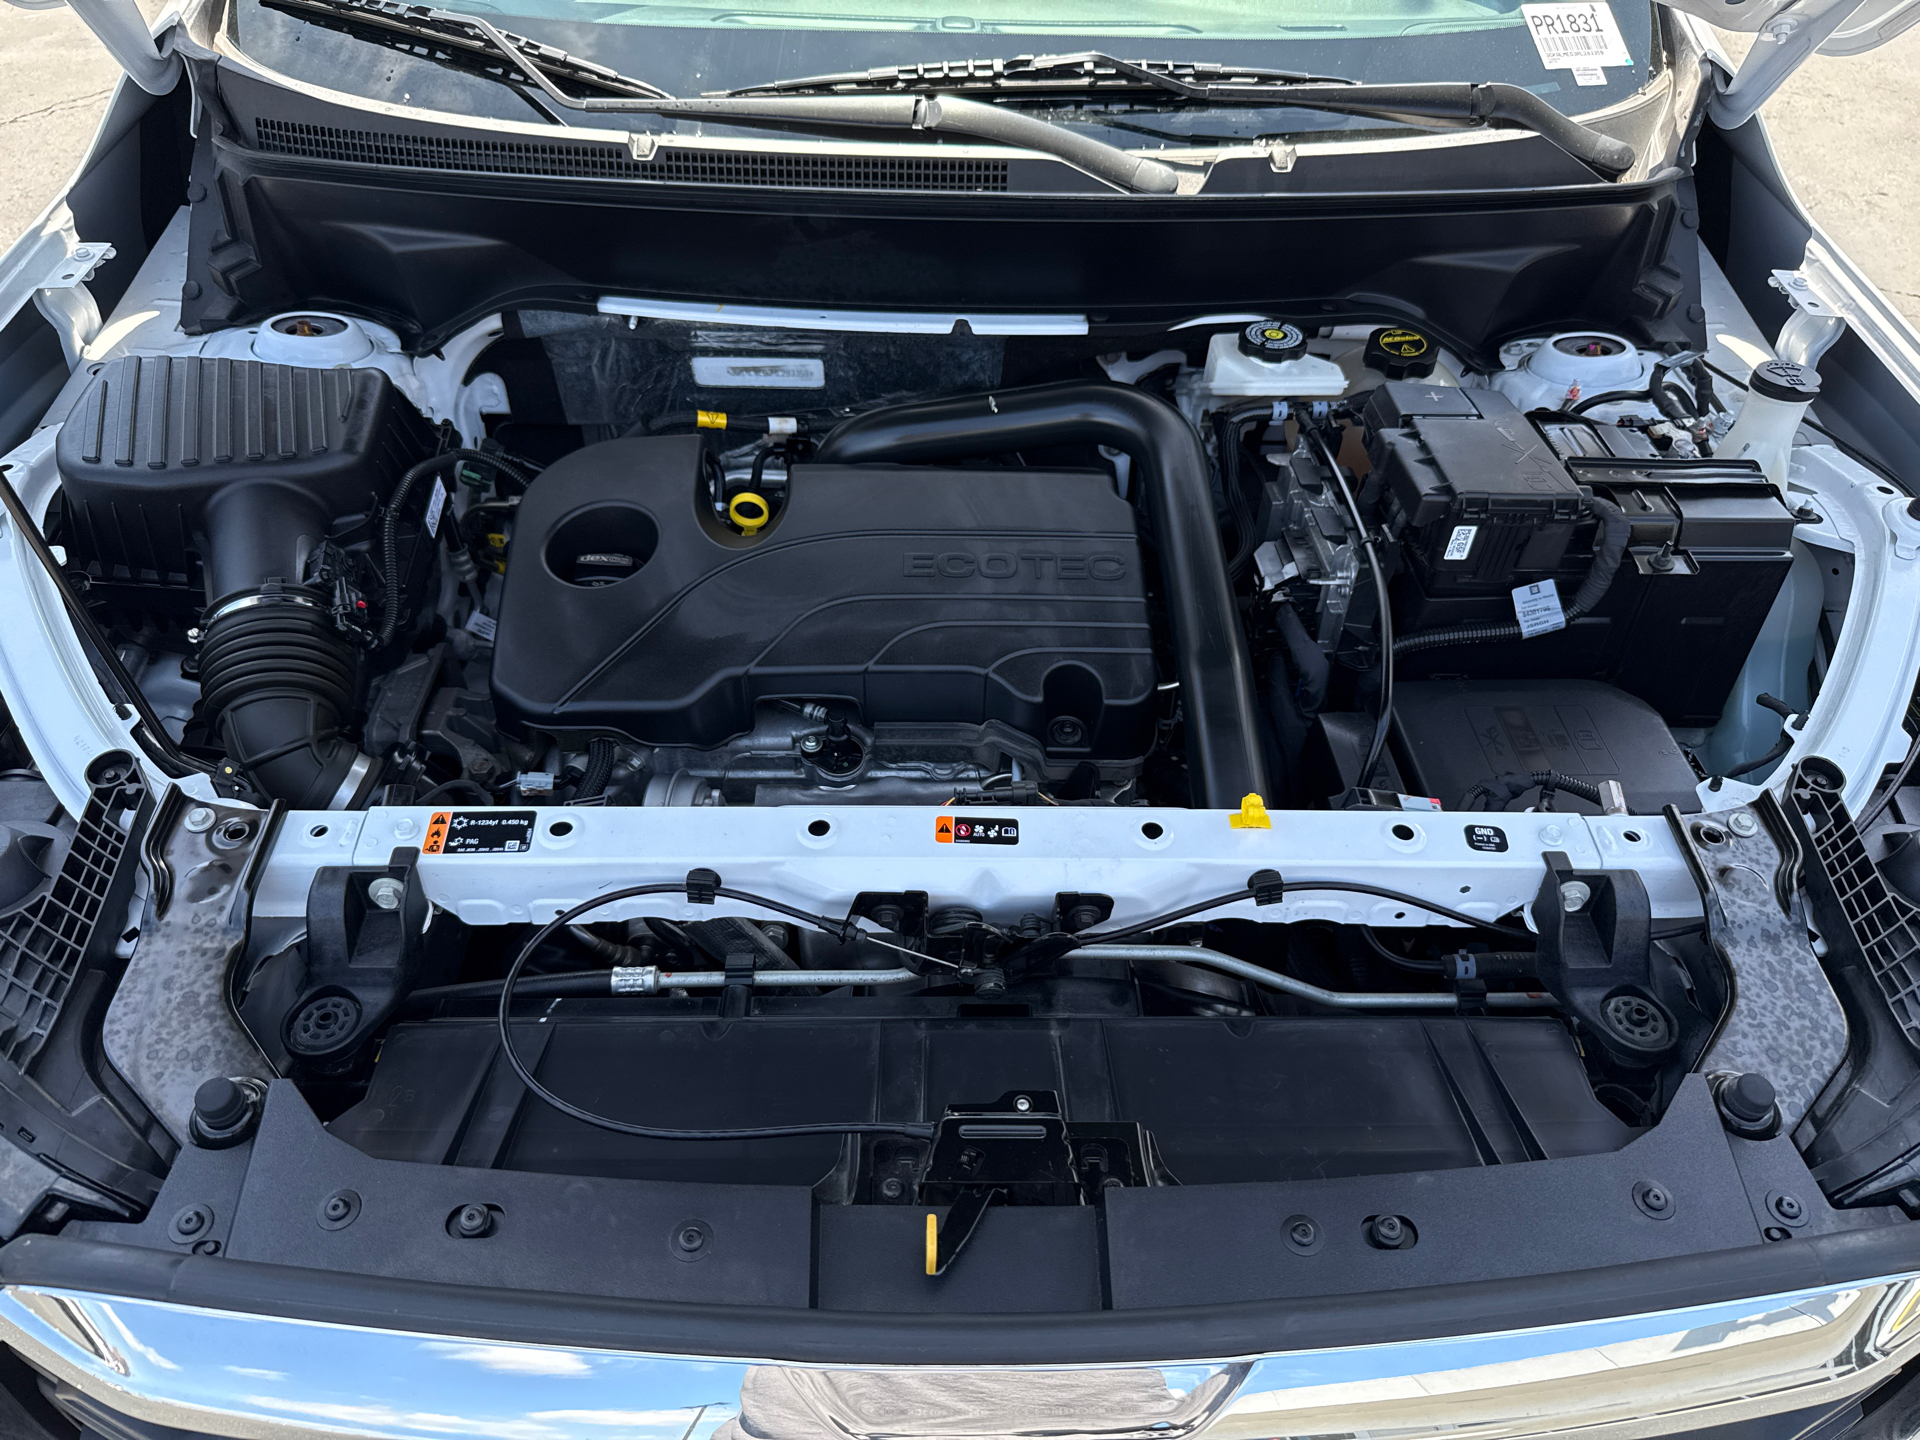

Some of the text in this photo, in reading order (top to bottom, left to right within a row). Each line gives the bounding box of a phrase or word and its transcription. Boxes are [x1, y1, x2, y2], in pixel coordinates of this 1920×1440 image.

[1530, 13, 1604, 35] PR1831
[580, 554, 629, 564] dexos
[902, 552, 1127, 581] ECOTEC
[1474, 827, 1494, 835] GND
